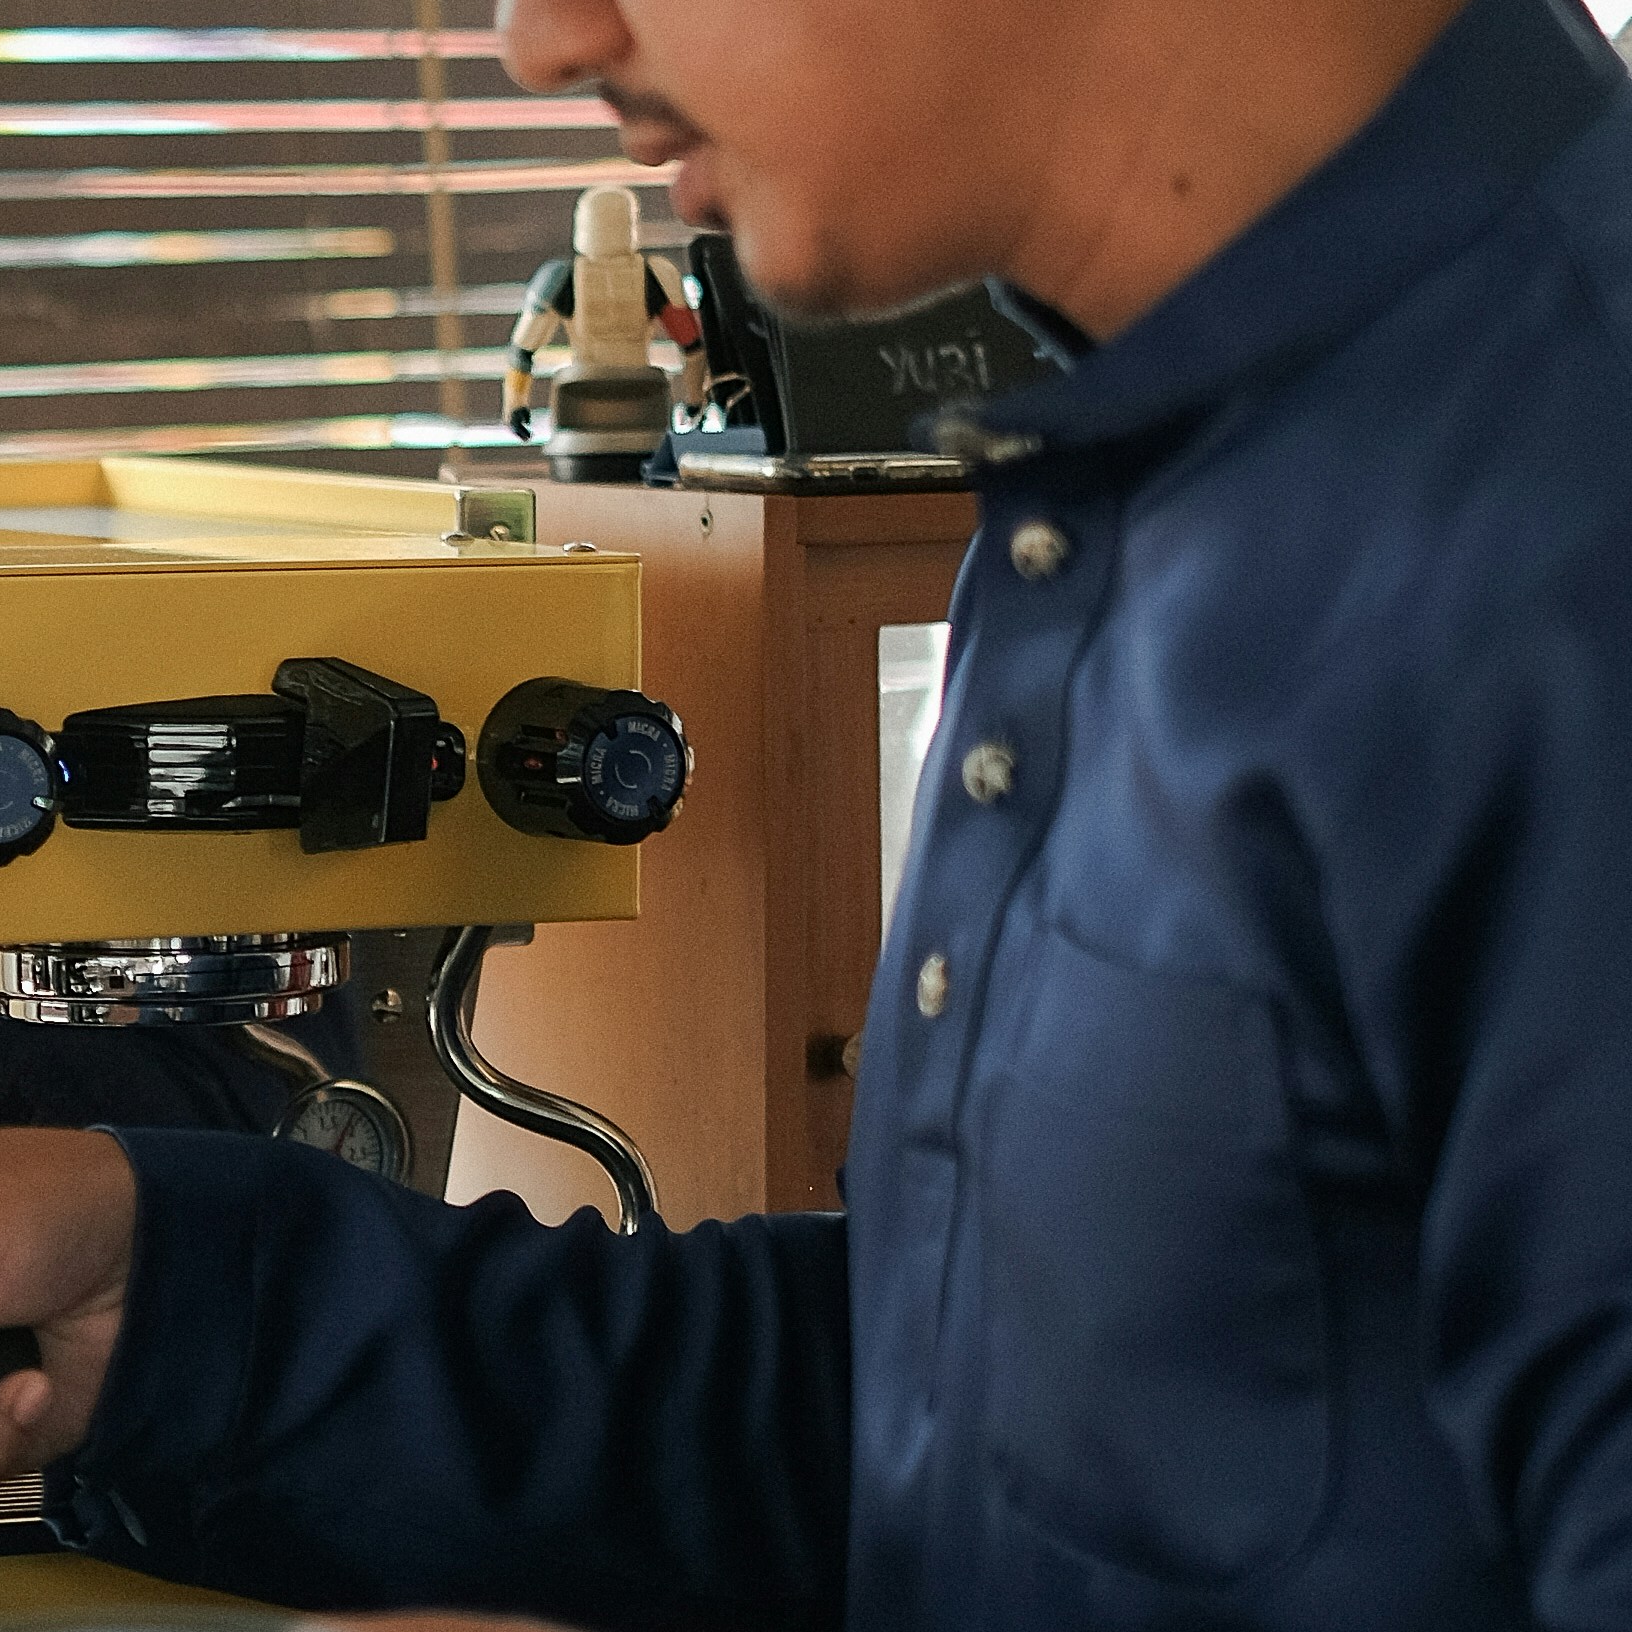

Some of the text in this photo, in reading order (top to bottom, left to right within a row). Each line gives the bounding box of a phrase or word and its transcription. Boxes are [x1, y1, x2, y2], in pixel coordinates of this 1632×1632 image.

[628, 721, 661, 741] MICRA
[590, 747, 607, 785] MICRA
[661, 754, 677, 792] MICRA
[605, 795, 639, 816] MICRA
